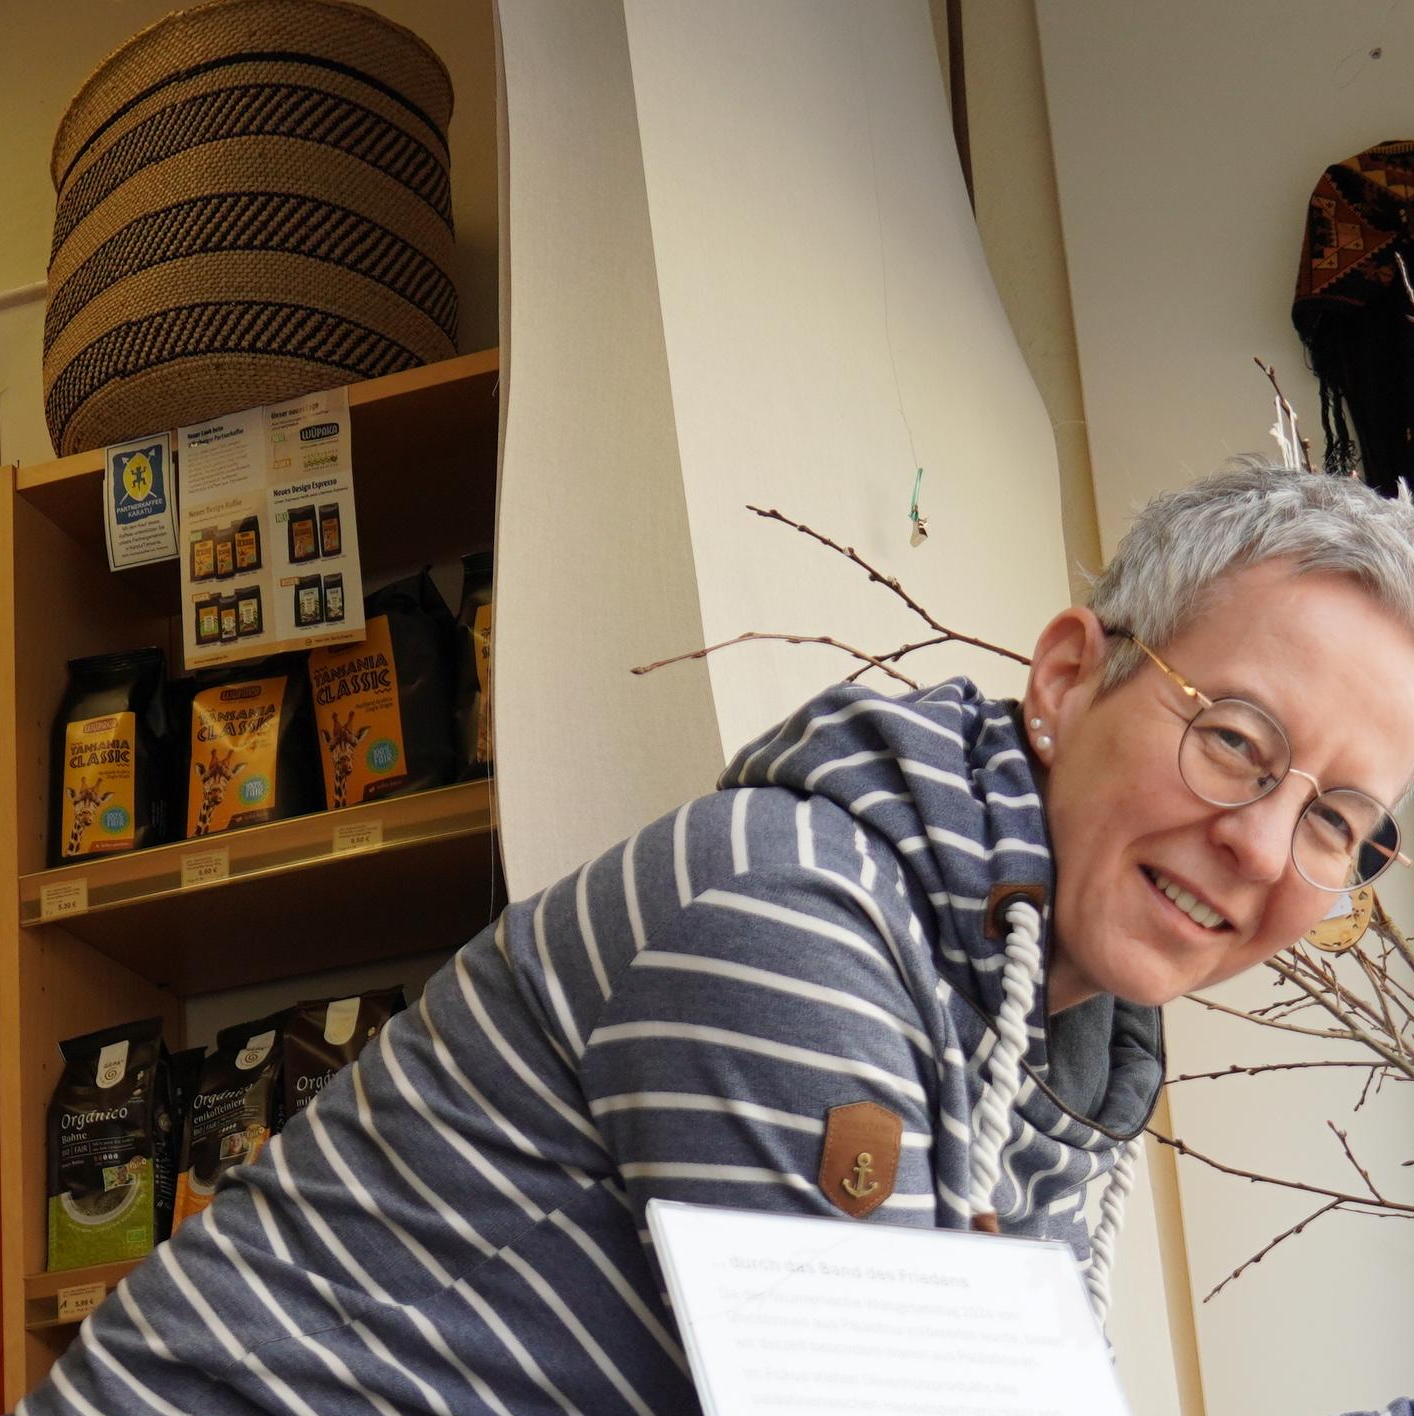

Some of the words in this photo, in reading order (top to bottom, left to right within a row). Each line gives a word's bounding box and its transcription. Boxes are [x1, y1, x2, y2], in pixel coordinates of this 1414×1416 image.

[292, 484, 311, 494] Design
[312, 479, 337, 490] Espresso
[116, 498, 163, 513] PARTNERKAFFEE
[128, 507, 152, 518] KARATU
[314, 653, 388, 687] TANSANIA
[316, 669, 391, 705] CLASSIC
[197, 715, 275, 742] CLASSIC
[71, 739, 130, 755] TANSANIA
[70, 750, 130, 768] CLASSIC
[61, 1104, 128, 1130] Orgánico
[192, 1098, 246, 1125] entkoffeiniert
[61, 1132, 87, 1145] Bohne
[74, 1144, 89, 1155] FAIR
[728, 1255, 782, 1273] durch
[785, 1260, 816, 1276] das
[819, 1261, 862, 1280] Band
[865, 1266, 896, 1283] des
[898, 1269, 970, 1289] Friedens
